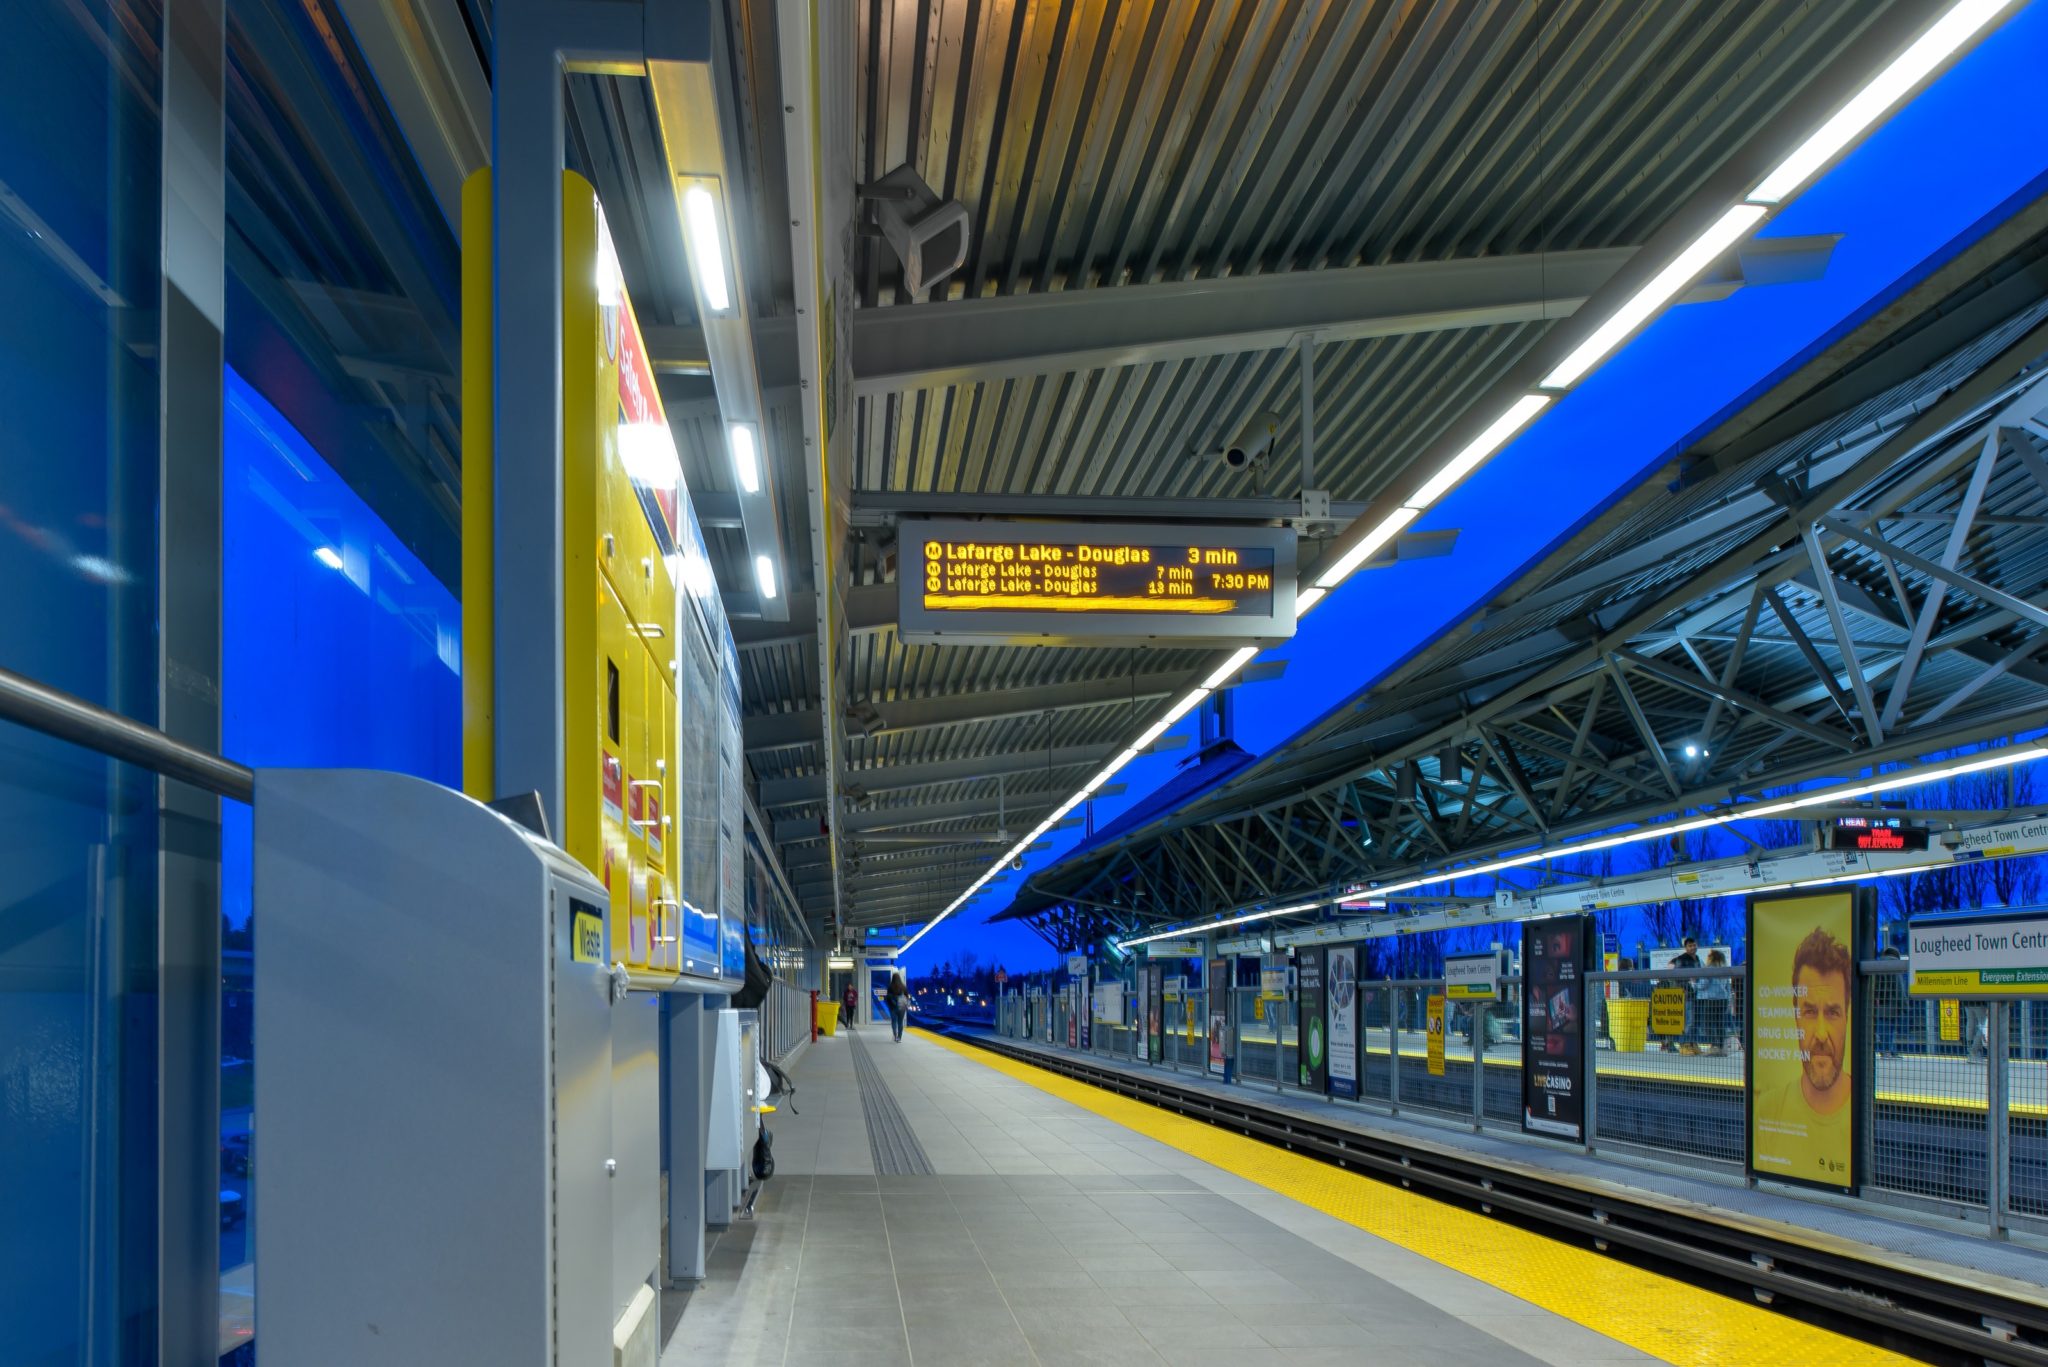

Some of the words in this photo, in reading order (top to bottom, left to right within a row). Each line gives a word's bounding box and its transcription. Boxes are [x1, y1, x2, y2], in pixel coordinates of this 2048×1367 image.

[947, 543, 1014, 563] Lafarge
[1020, 544, 1062, 561] Lake
[1078, 545, 1150, 565] Douglas
[1188, 547, 1200, 564] 3
[1205, 548, 1238, 564] min
[947, 561, 996, 578] Lafarge
[1000, 562, 1032, 577] Lake
[1044, 564, 1097, 580] Douglas
[1156, 566, 1165, 579] 7
[1169, 565, 1193, 580] min
[947, 577, 996, 594] Lafarge
[1000, 577, 1032, 592] Lake
[1044, 579, 1097, 595] Douglas
[1169, 580, 1193, 595] min
[1211, 573, 1244, 589] 7:30
[1247, 574, 1269, 590] PM
[1994, 829, 2020, 842] Town
[2021, 824, 2048, 838] Centr
[578, 917, 600, 959] Waste
[1914, 934, 1971, 956] Lougheed
[1975, 934, 2008, 951] Town
[2012, 932, 2048, 949] Centr
[1917, 976, 1953, 986] Millennium
[1954, 976, 1968, 986] Line
[1982, 971, 2015, 984] Evergreen
[2016, 969, 2048, 982] Extensio
[1653, 993, 1683, 1004] CAUTION
[1759, 985, 1808, 998] CO-WORKER
[1758, 1007, 1801, 1018] TEAMMATE
[1758, 1027, 1781, 1039] DRUG
[1783, 1028, 1805, 1040] USER
[1758, 1048, 1791, 1060] HOCKEY
